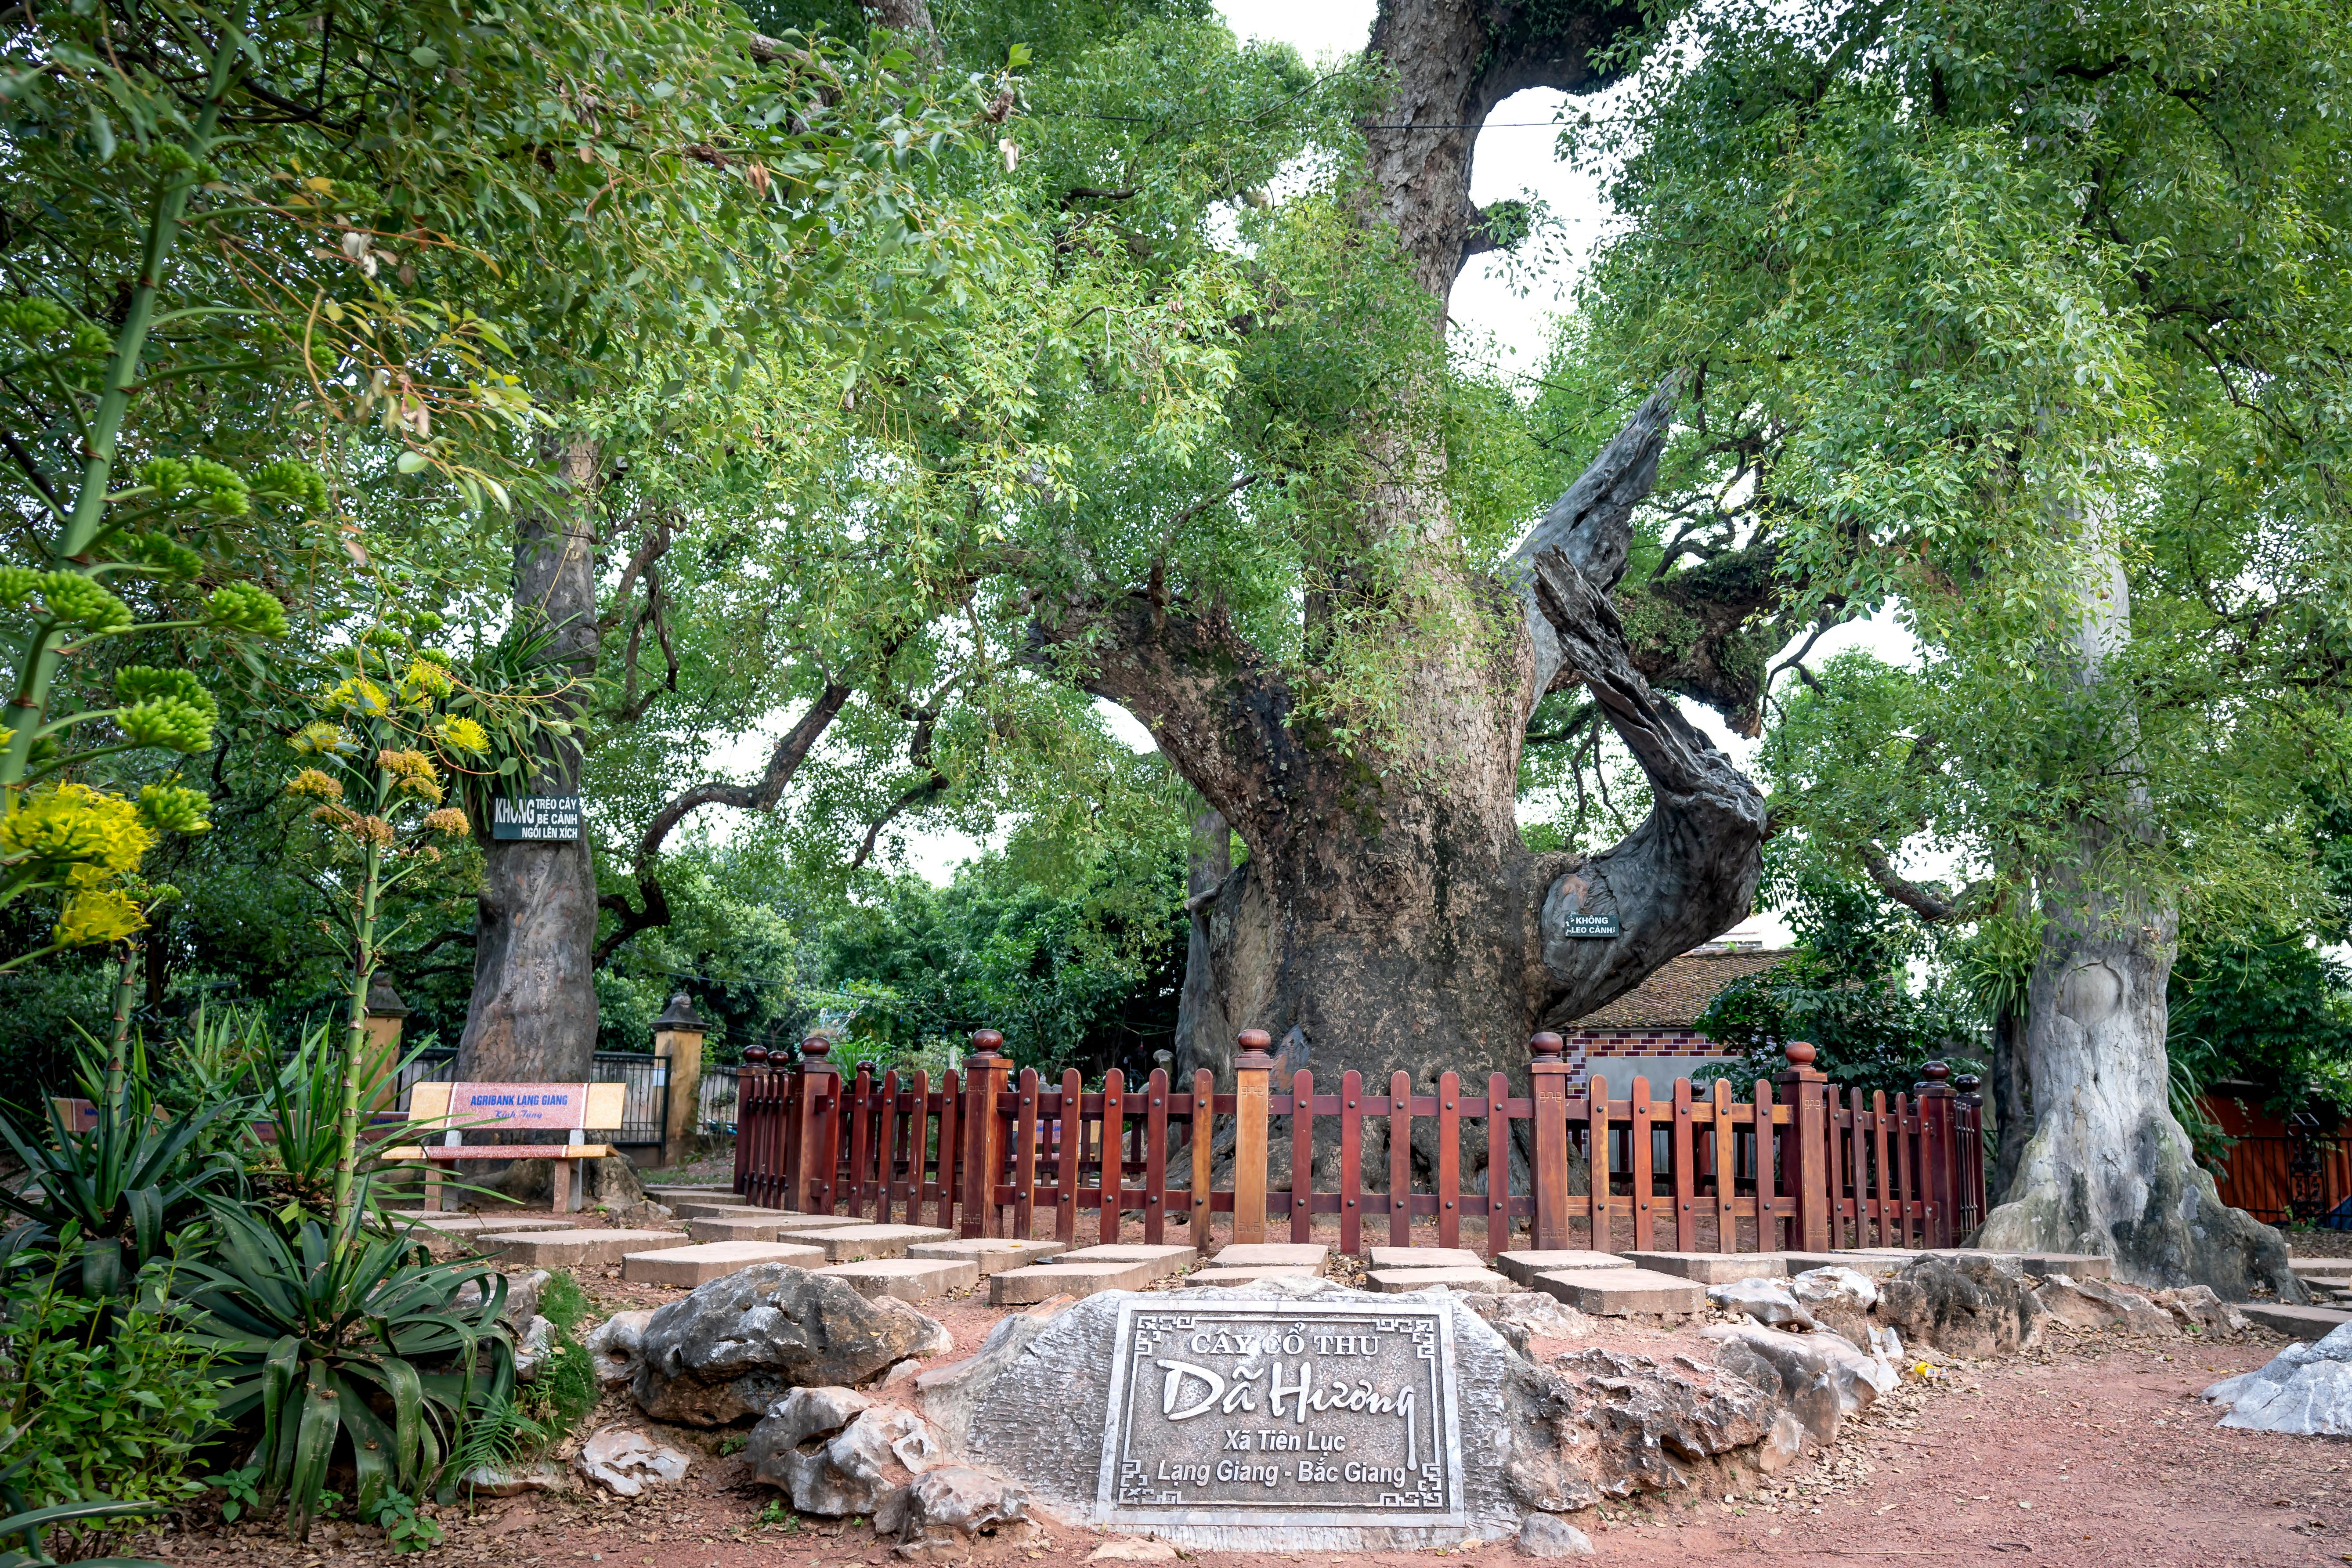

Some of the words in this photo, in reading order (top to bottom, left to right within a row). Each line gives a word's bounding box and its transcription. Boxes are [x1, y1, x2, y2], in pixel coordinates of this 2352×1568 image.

[535, 796, 556, 809] TRÈO
[559, 797, 577, 810] CÂY
[537, 810, 549, 824] BẺ
[551, 812, 577, 824] CÀNH
[522, 824, 541, 838] NGỒI
[543, 825, 557, 838] LÊN
[559, 825, 577, 838] XÍCH
[1575, 915, 1608, 924] KHÔNG
[1589, 925, 1613, 933] CÀNH
[470, 1095, 514, 1106] AGRIBANK
[542, 1095, 568, 1106] GIANG
[1191, 1328, 1254, 1356] CÂY
[1261, 1322, 1305, 1355] CỔ
[1313, 1335, 1382, 1361] THỤ
[1156, 1359, 1264, 1421] Dã
[1223, 1429, 1251, 1451] Xã
[1257, 1429, 1301, 1452] Tiên
[1307, 1431, 1346, 1456] Lục
[1157, 1460, 1211, 1488] Lạng
[1216, 1460, 1279, 1488] Giang
[1298, 1456, 1339, 1483] Bắc
[1344, 1461, 1406, 1489] Giang
